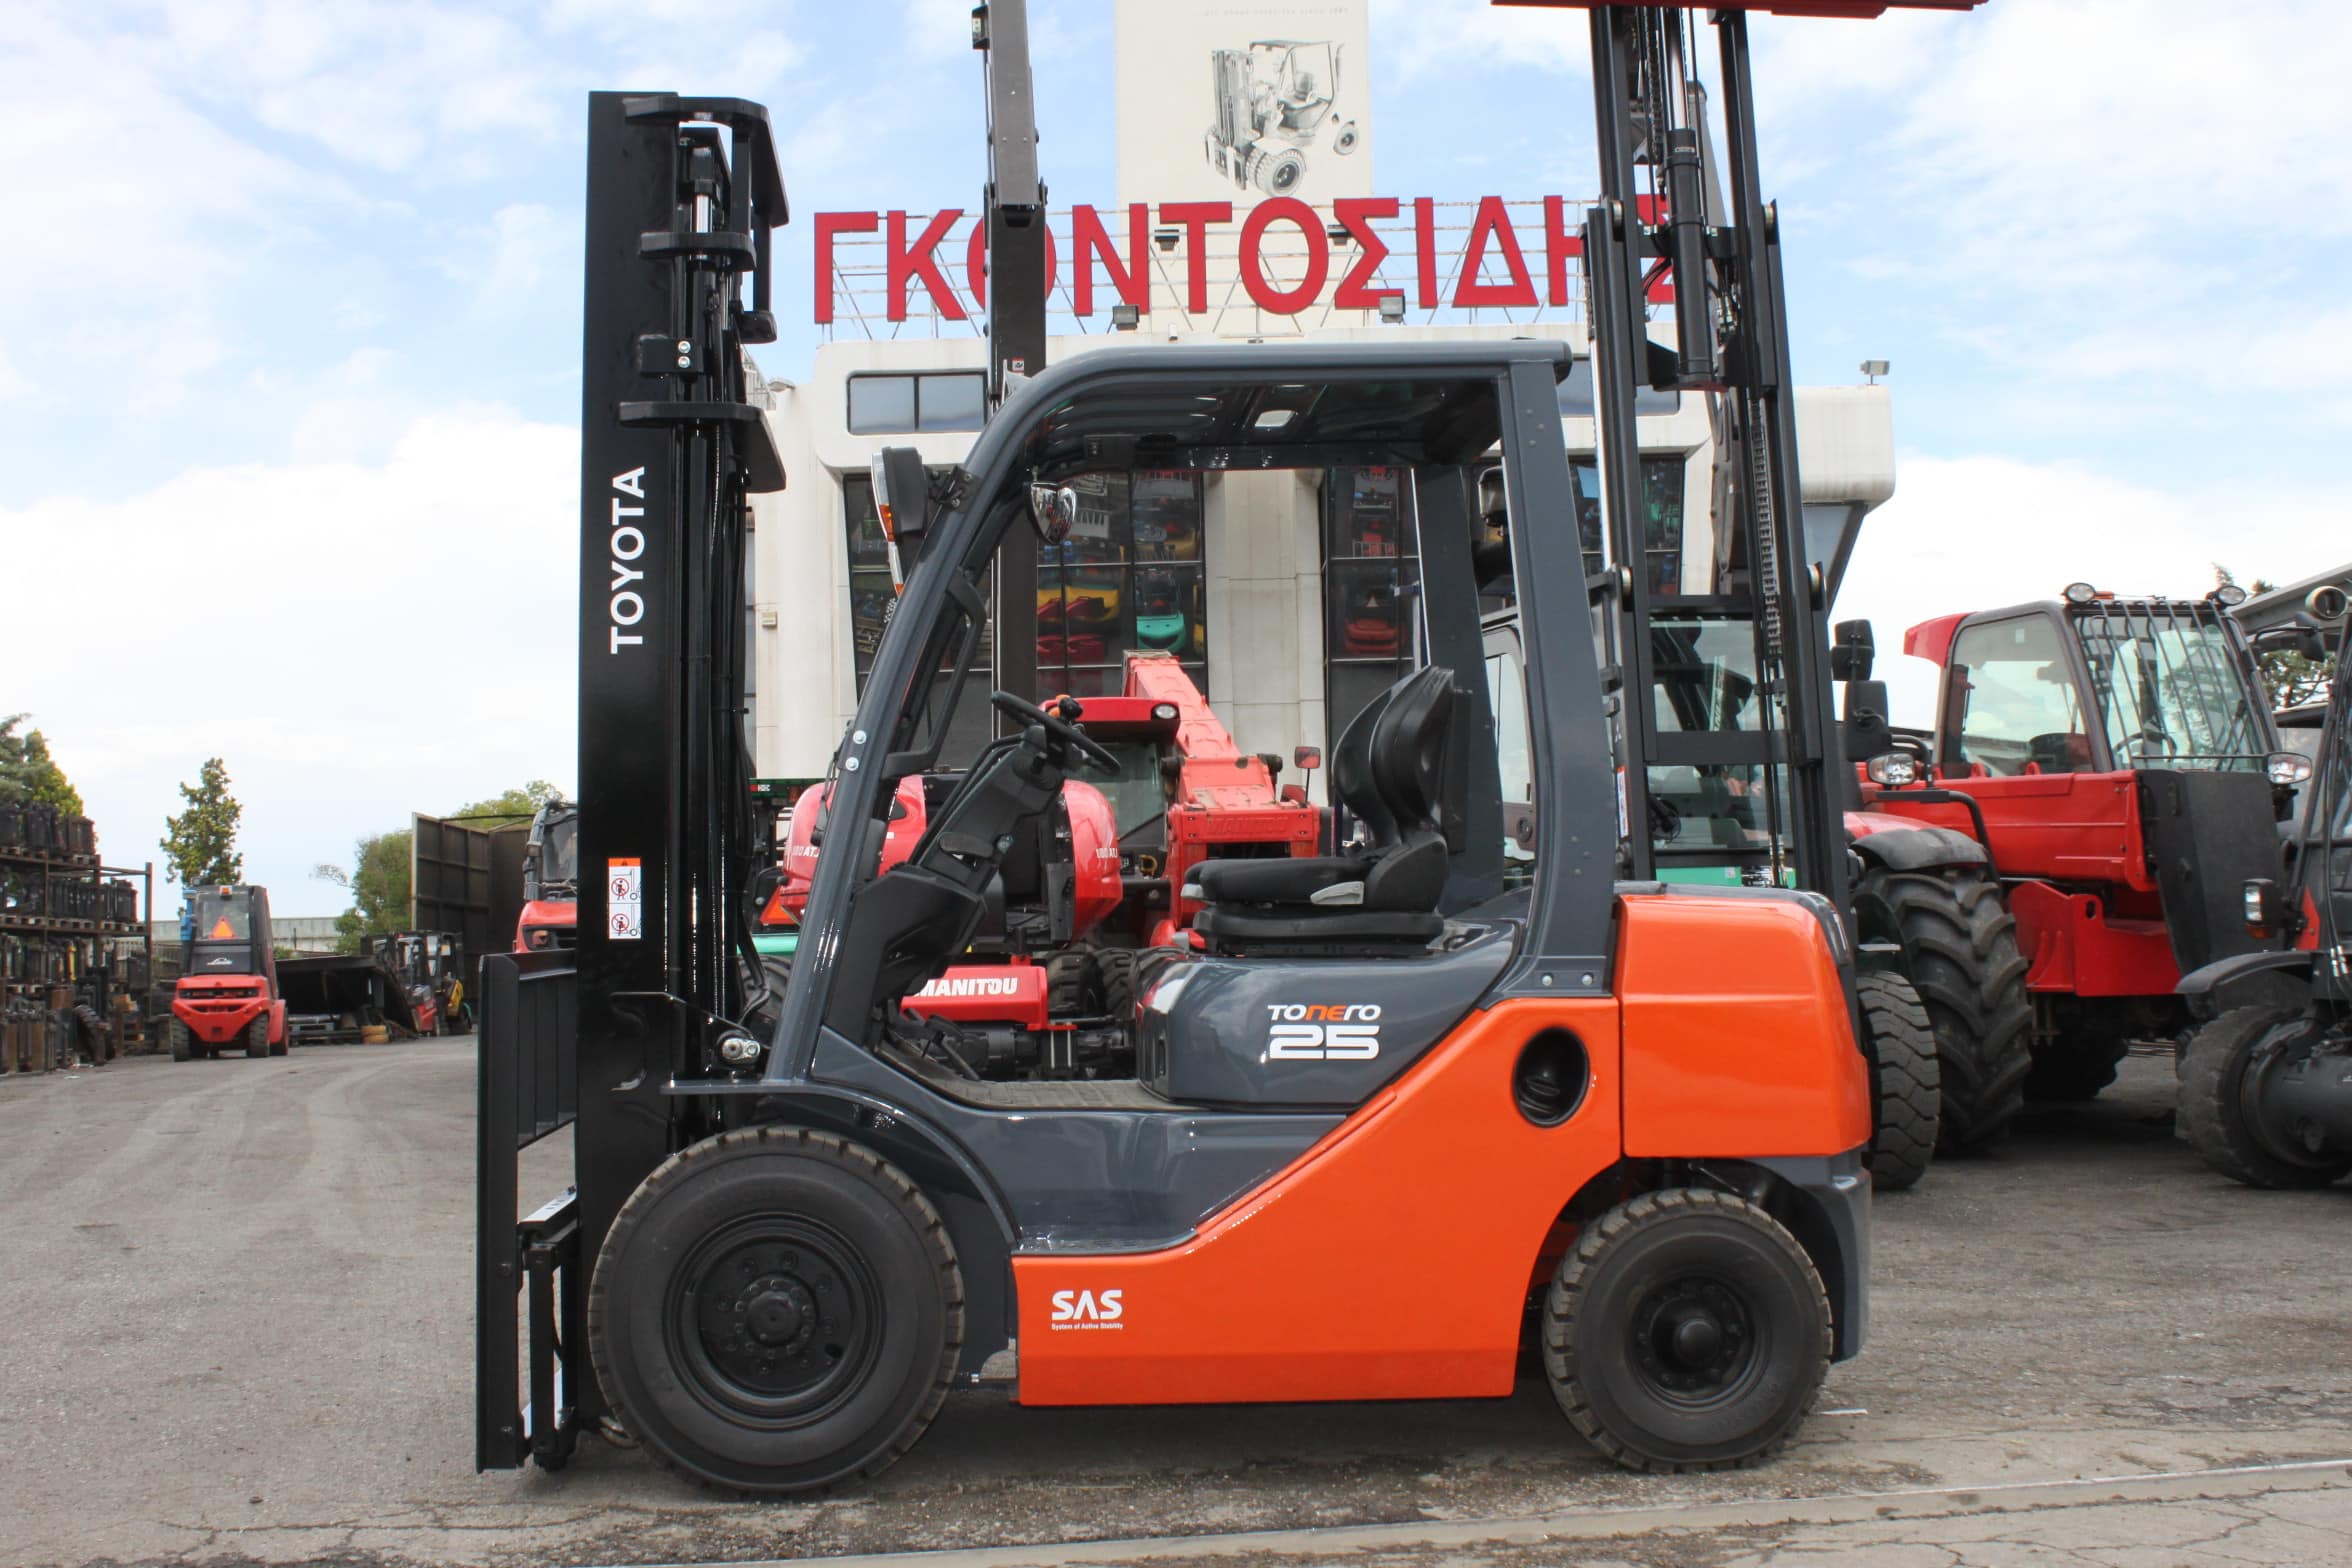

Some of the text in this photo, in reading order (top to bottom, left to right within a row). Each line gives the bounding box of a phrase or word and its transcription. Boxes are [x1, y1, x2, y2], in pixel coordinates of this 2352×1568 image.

[814, 195, 1675, 324] ΓΚΝΤΟΣΙΔΗ
[610, 466, 645, 654] TOYOTA
[914, 977, 1018, 998] MANITOU
[1269, 1025, 1380, 1060] 25
[1051, 1289, 1123, 1320] SAS
